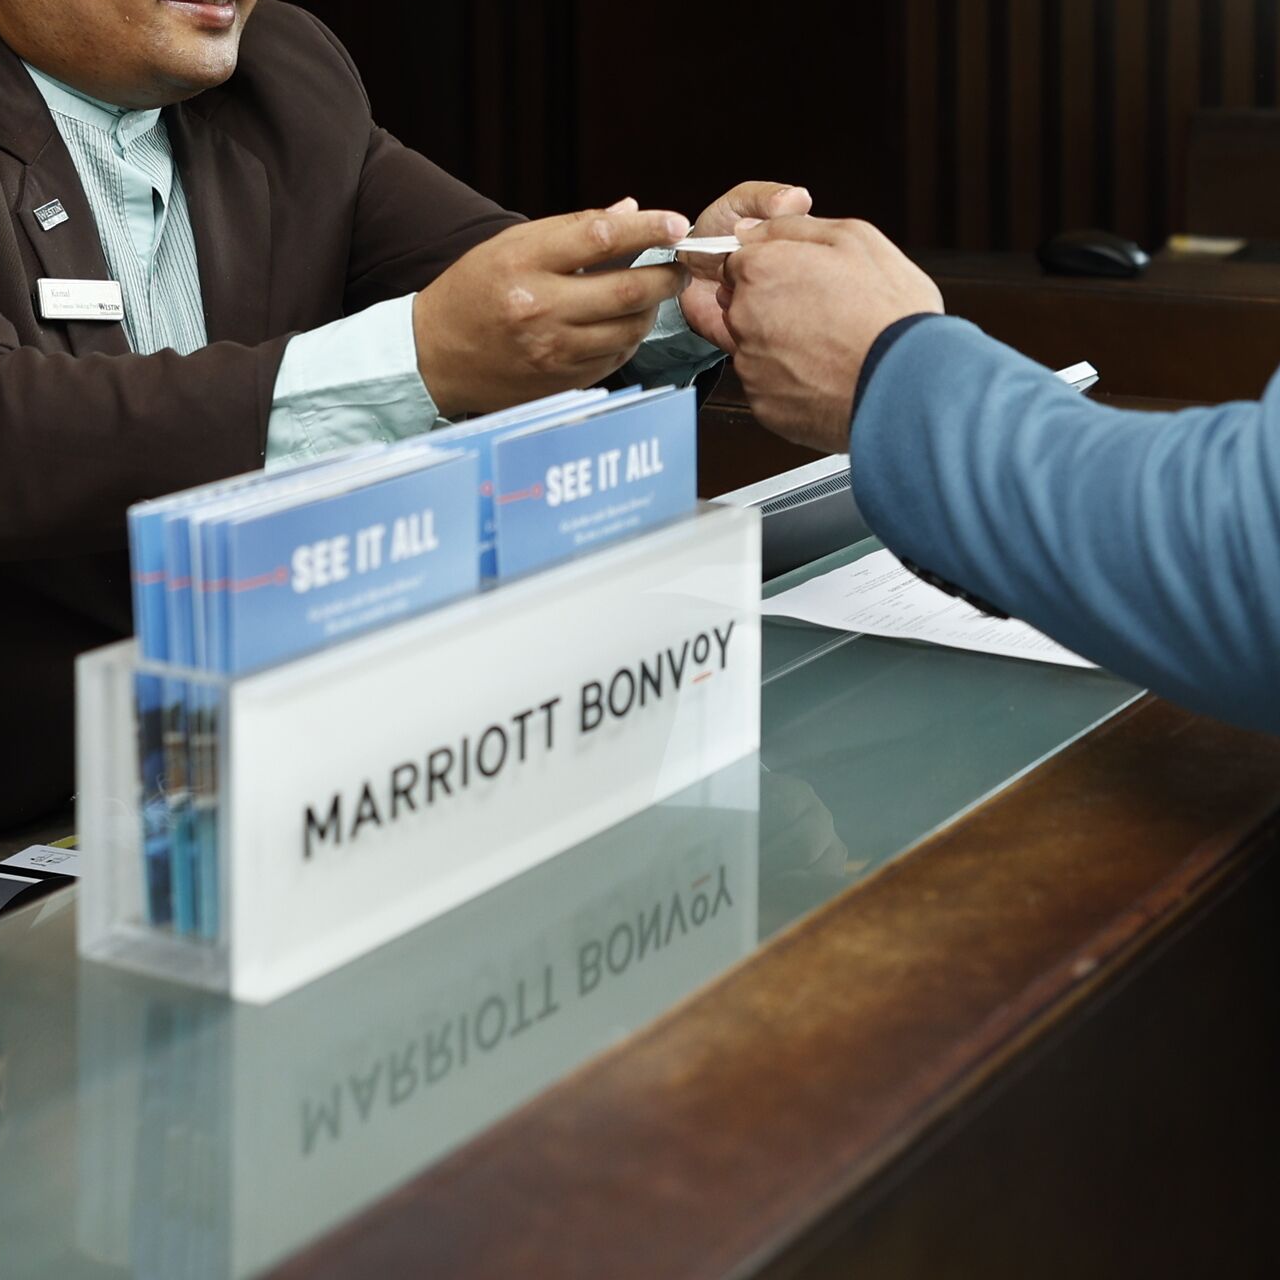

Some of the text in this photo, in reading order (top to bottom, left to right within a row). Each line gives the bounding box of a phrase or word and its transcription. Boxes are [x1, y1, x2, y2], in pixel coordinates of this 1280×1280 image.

[546, 437, 664, 507] SEE IT ALL
[291, 508, 440, 594] SEE IT ALL
[302, 620, 735, 861] MARRIOTT BONVOY
